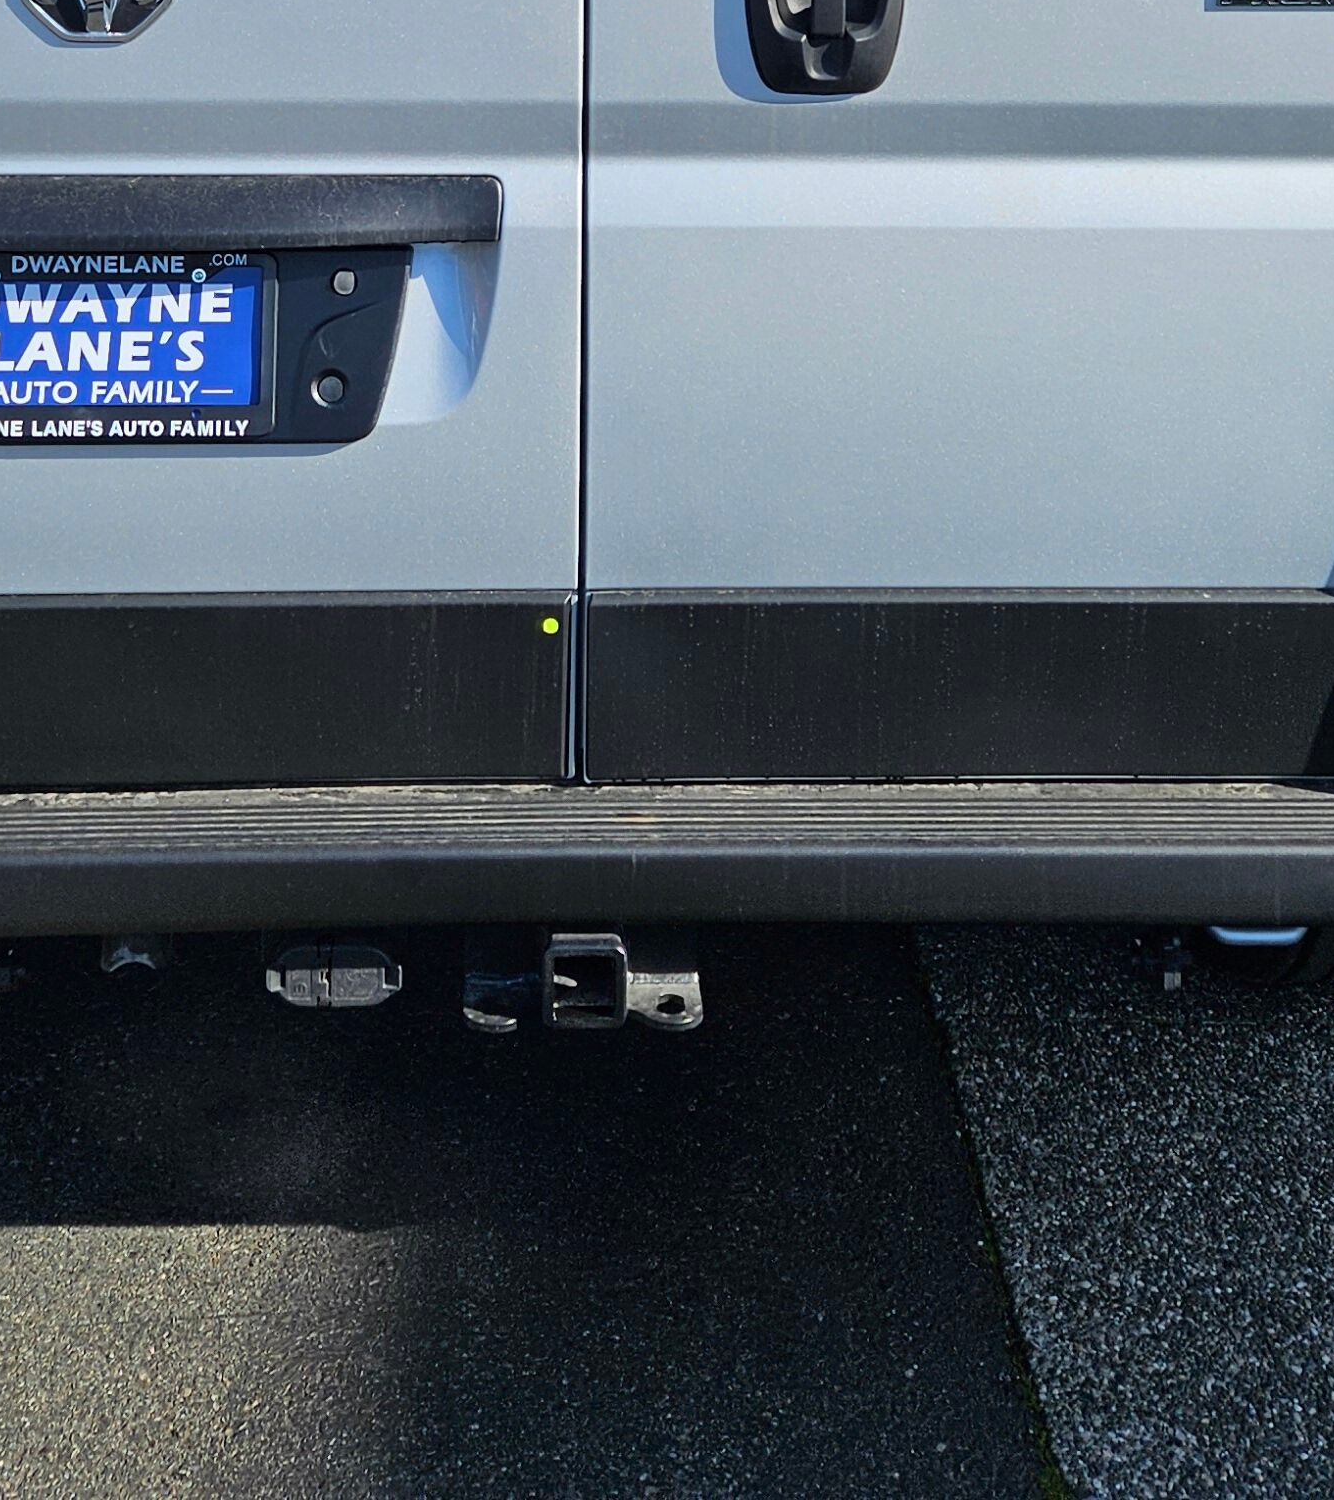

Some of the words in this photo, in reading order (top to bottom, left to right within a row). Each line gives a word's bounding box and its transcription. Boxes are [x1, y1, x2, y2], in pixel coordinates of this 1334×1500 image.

[11, 255, 185, 274] DWAYNELANE
[208, 253, 248, 267] .COM
[90, 380, 199, 404] FAMILY
[31, 420, 103, 437] LANE'S
[109, 419, 165, 437] AUTO
[169, 419, 249, 437] FAMILY
